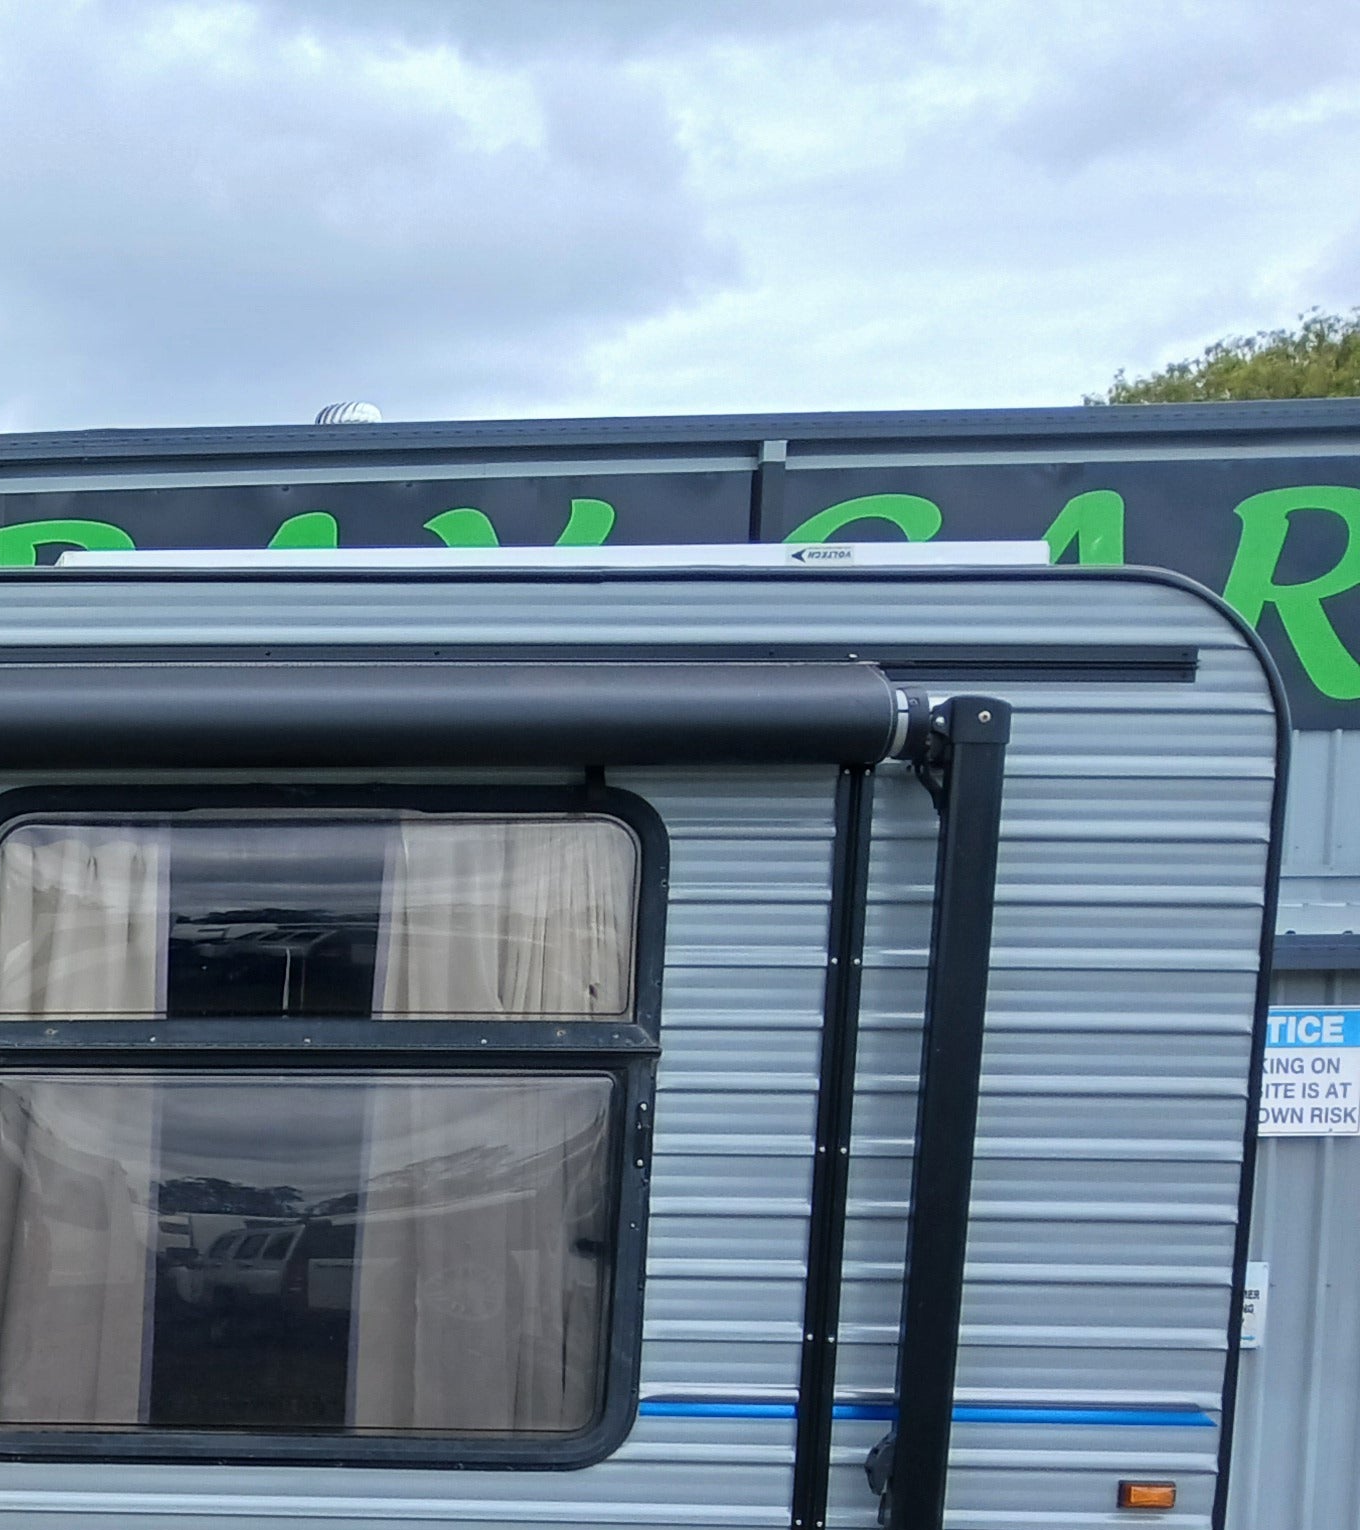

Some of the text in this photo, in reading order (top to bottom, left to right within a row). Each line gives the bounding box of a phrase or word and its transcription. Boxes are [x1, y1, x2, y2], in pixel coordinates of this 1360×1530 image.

[1267, 1015, 1345, 1044] TICE
[1311, 1057, 1341, 1074] ON
[1262, 1082, 1353, 1099] ITE IS AT
[1259, 1106, 1357, 1124] OWN RISK
